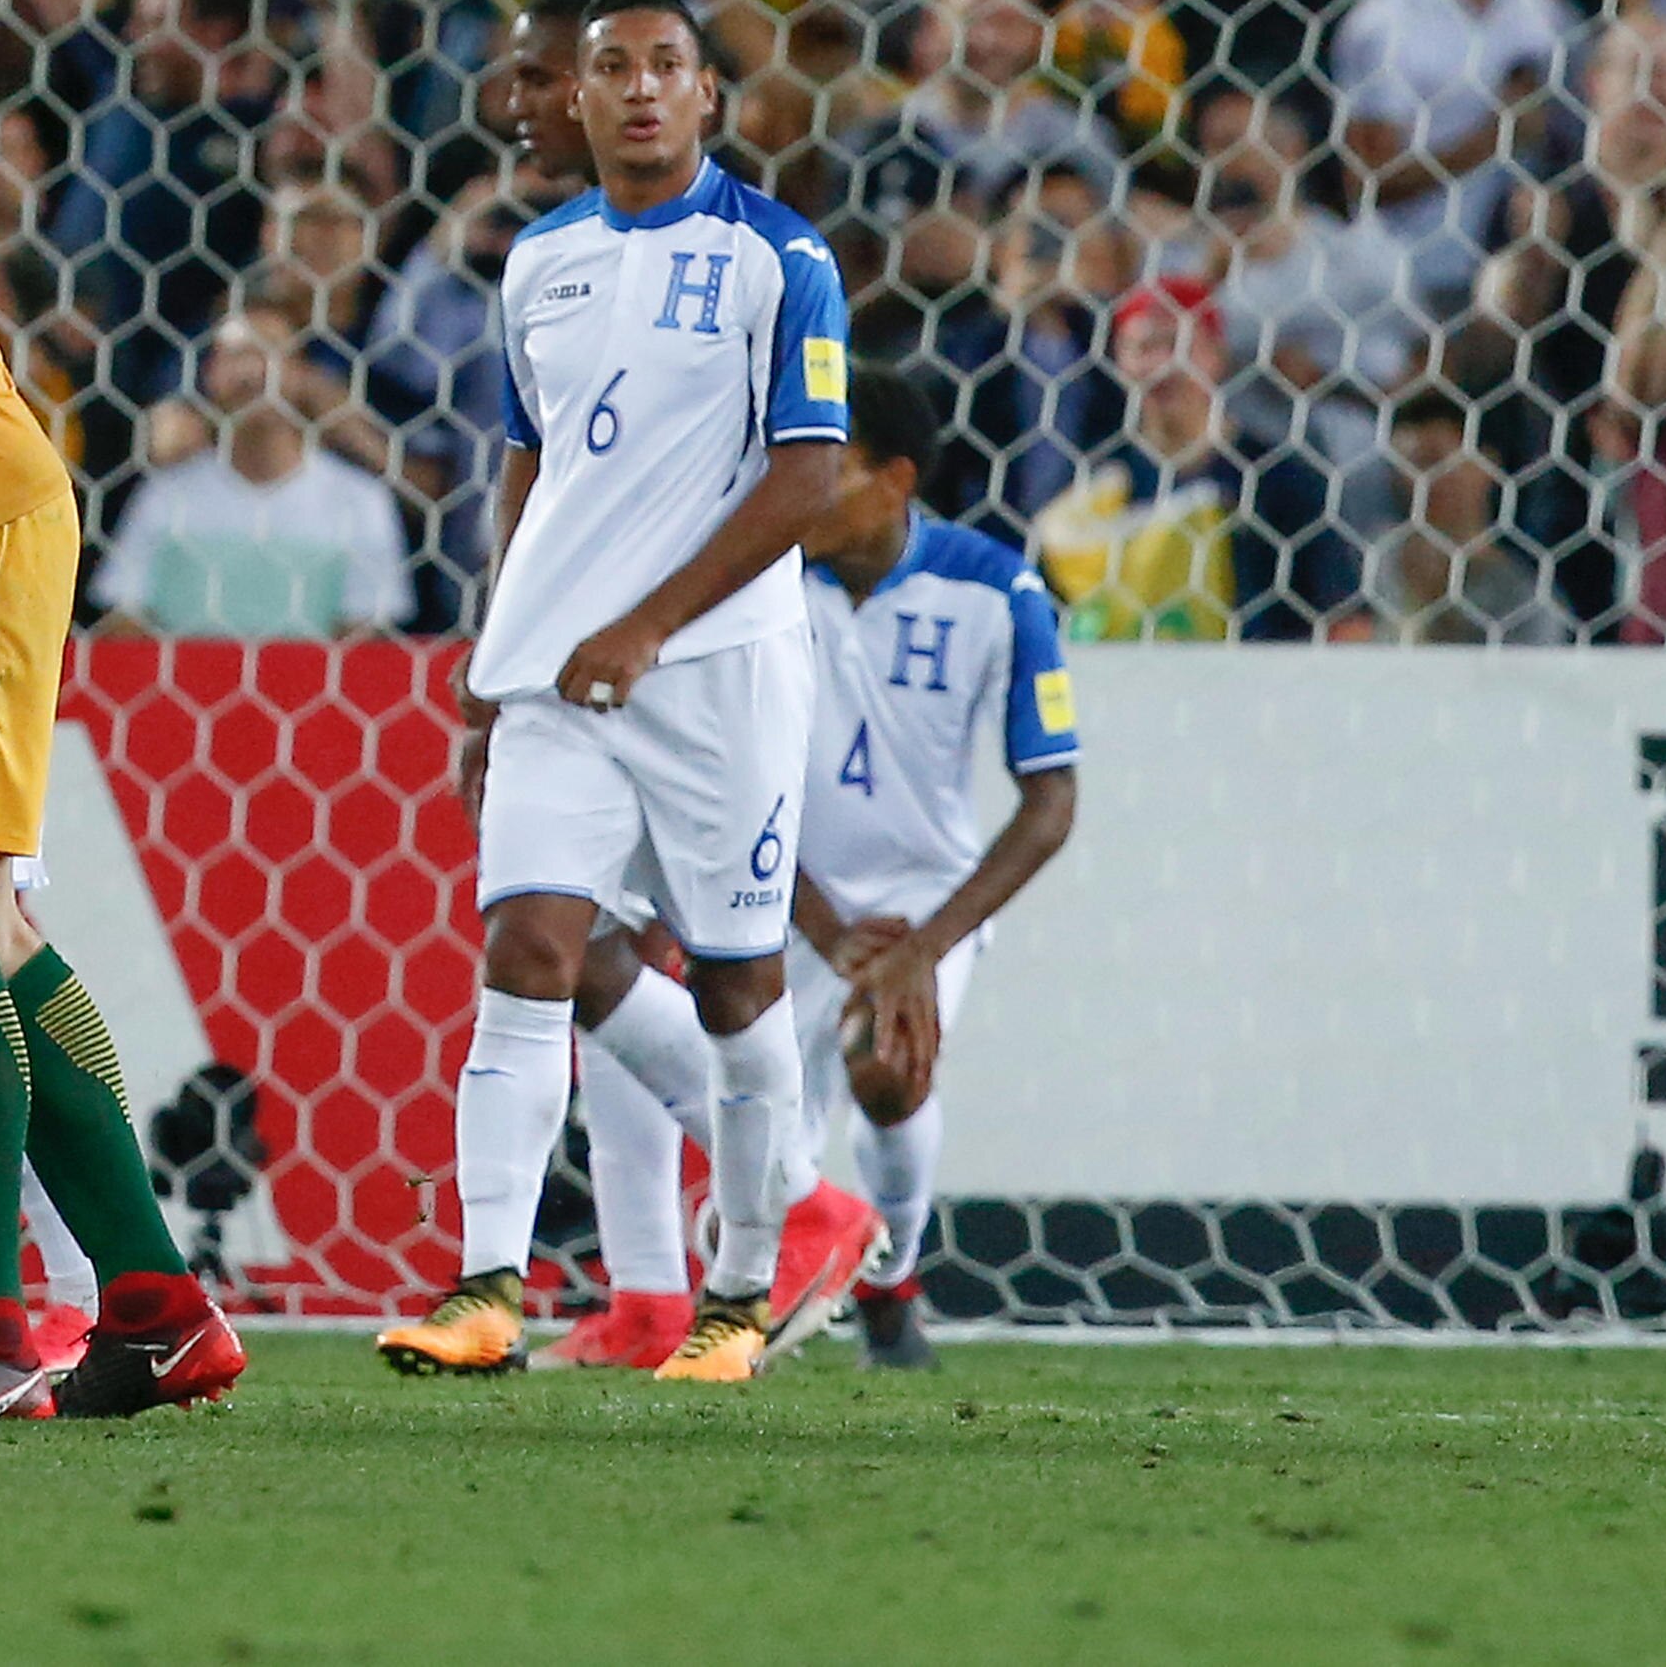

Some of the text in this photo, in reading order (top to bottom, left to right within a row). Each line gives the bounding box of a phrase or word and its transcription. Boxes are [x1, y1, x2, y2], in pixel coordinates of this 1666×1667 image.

[654, 252, 732, 332] H
[586, 369, 626, 456] 6
[889, 612, 954, 692] H
[841, 720, 874, 798] 4
[751, 795, 785, 882] 6
